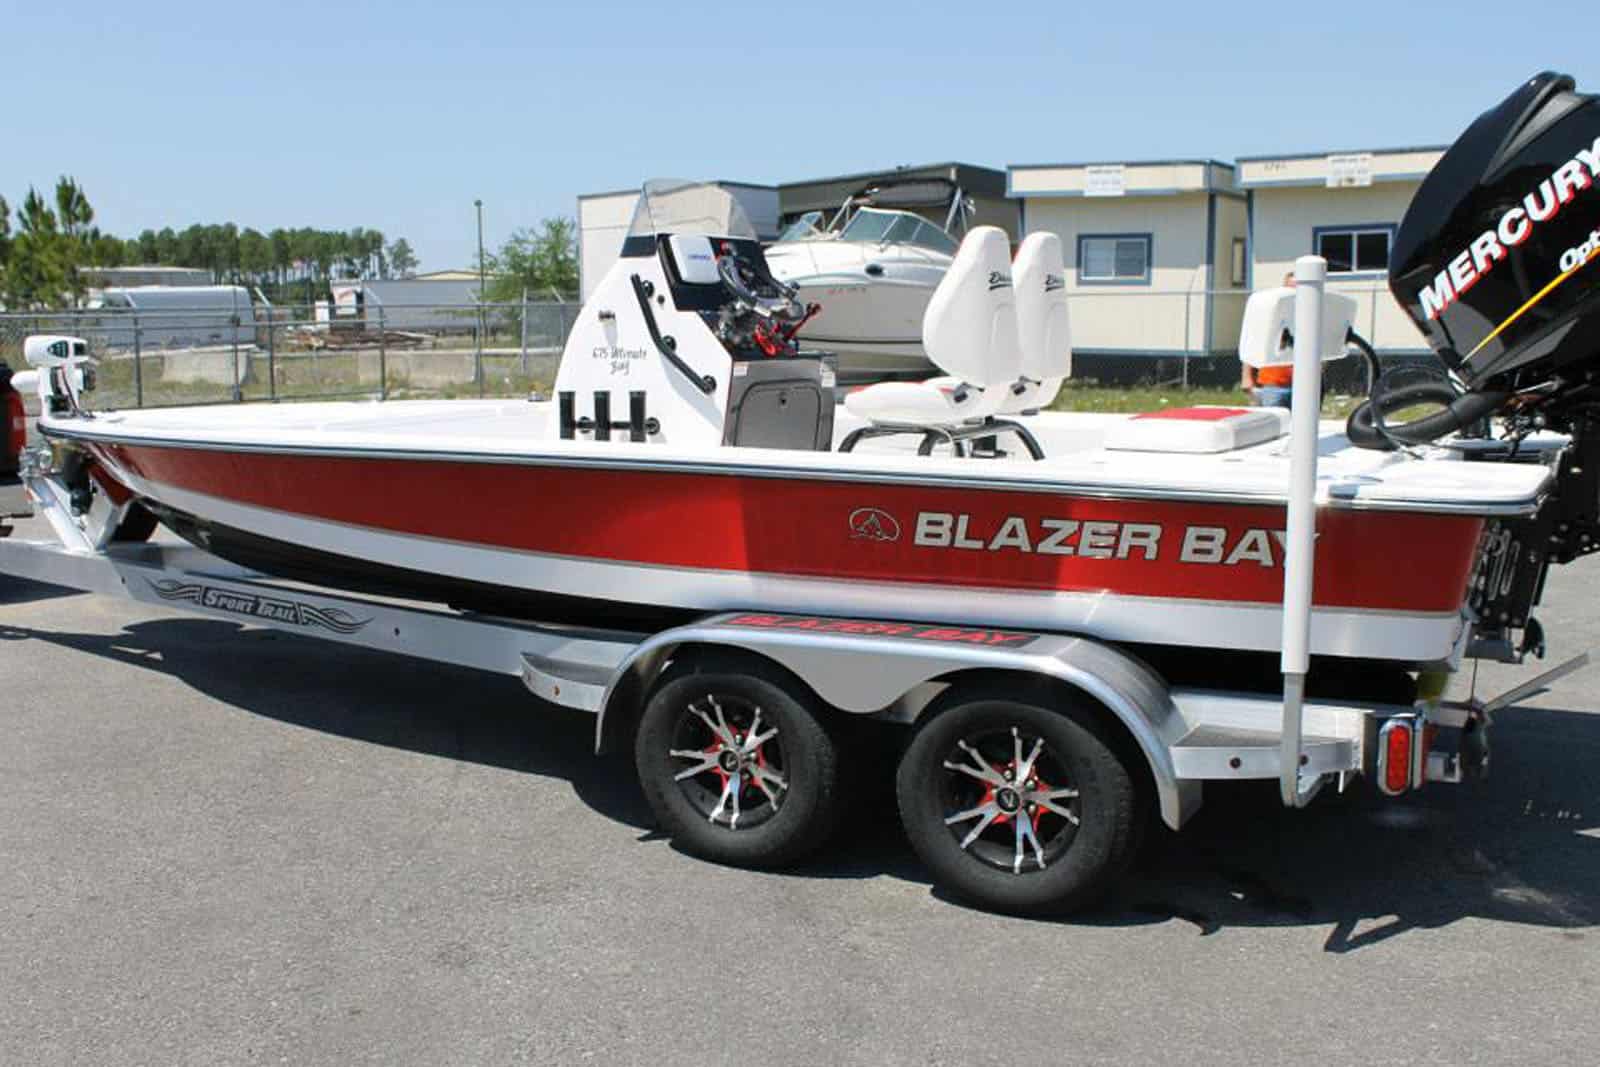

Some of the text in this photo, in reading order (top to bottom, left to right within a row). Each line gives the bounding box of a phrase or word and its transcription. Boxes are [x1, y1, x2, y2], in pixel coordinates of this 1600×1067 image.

[1417, 136, 1600, 321] MERCURY
[913, 511, 1163, 561] BLAZER
[726, 614, 1029, 645] BLAZER BAY
